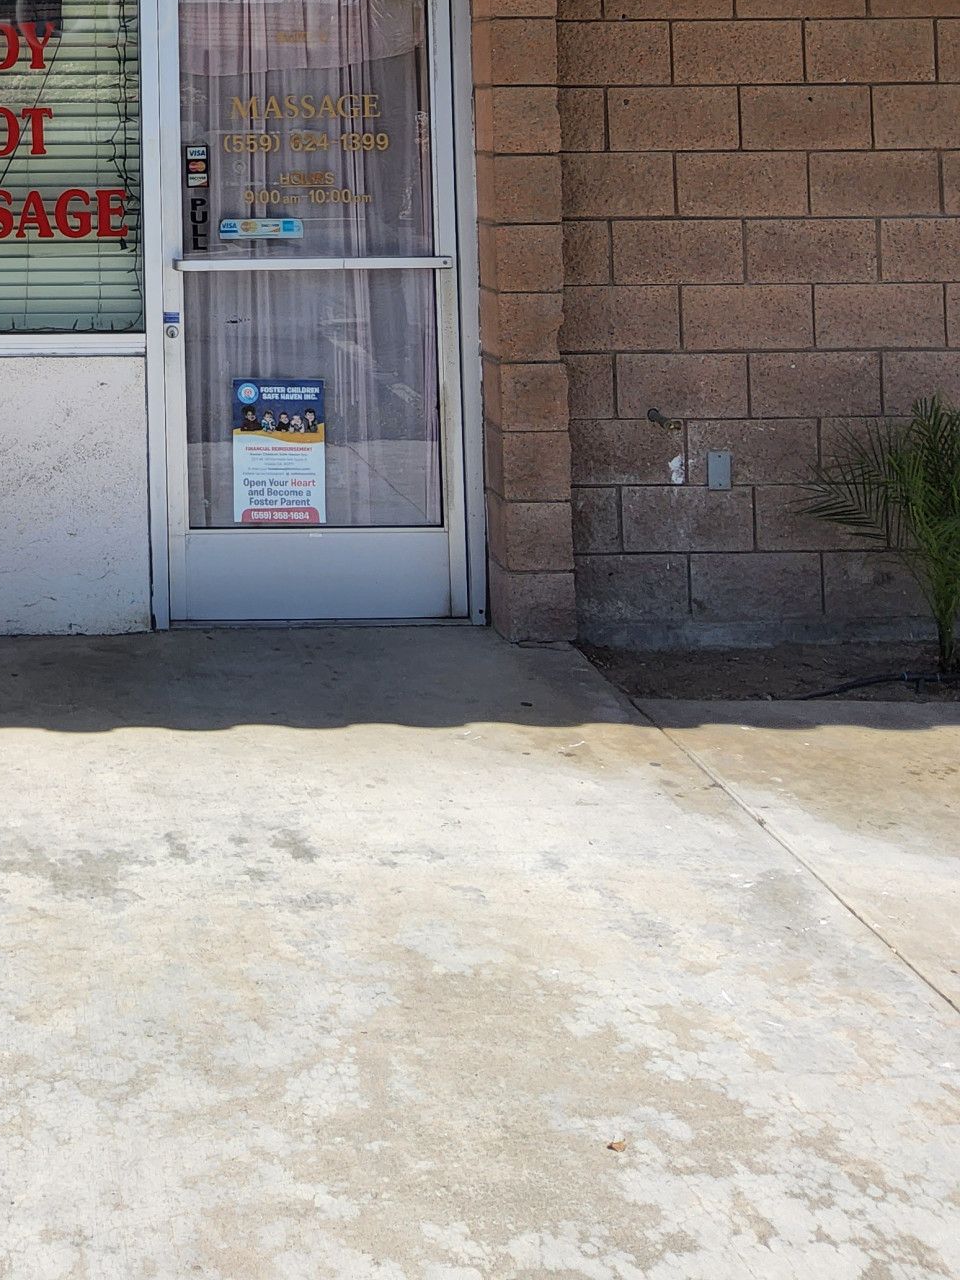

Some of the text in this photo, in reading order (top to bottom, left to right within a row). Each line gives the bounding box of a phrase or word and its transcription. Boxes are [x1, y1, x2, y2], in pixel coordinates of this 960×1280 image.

[228, 94, 382, 120] MASSAGE
[223, 133, 281, 153] (559)
[189, 149, 206, 157] VISA
[280, 171, 336, 185] HOURS
[190, 197, 208, 251] PULL
[287, 386, 320, 394] CHILDREN
[243, 478, 316, 488] Open Your Heart
[248, 488, 312, 497] and Become a
[249, 497, 311, 506] Foster Parent
